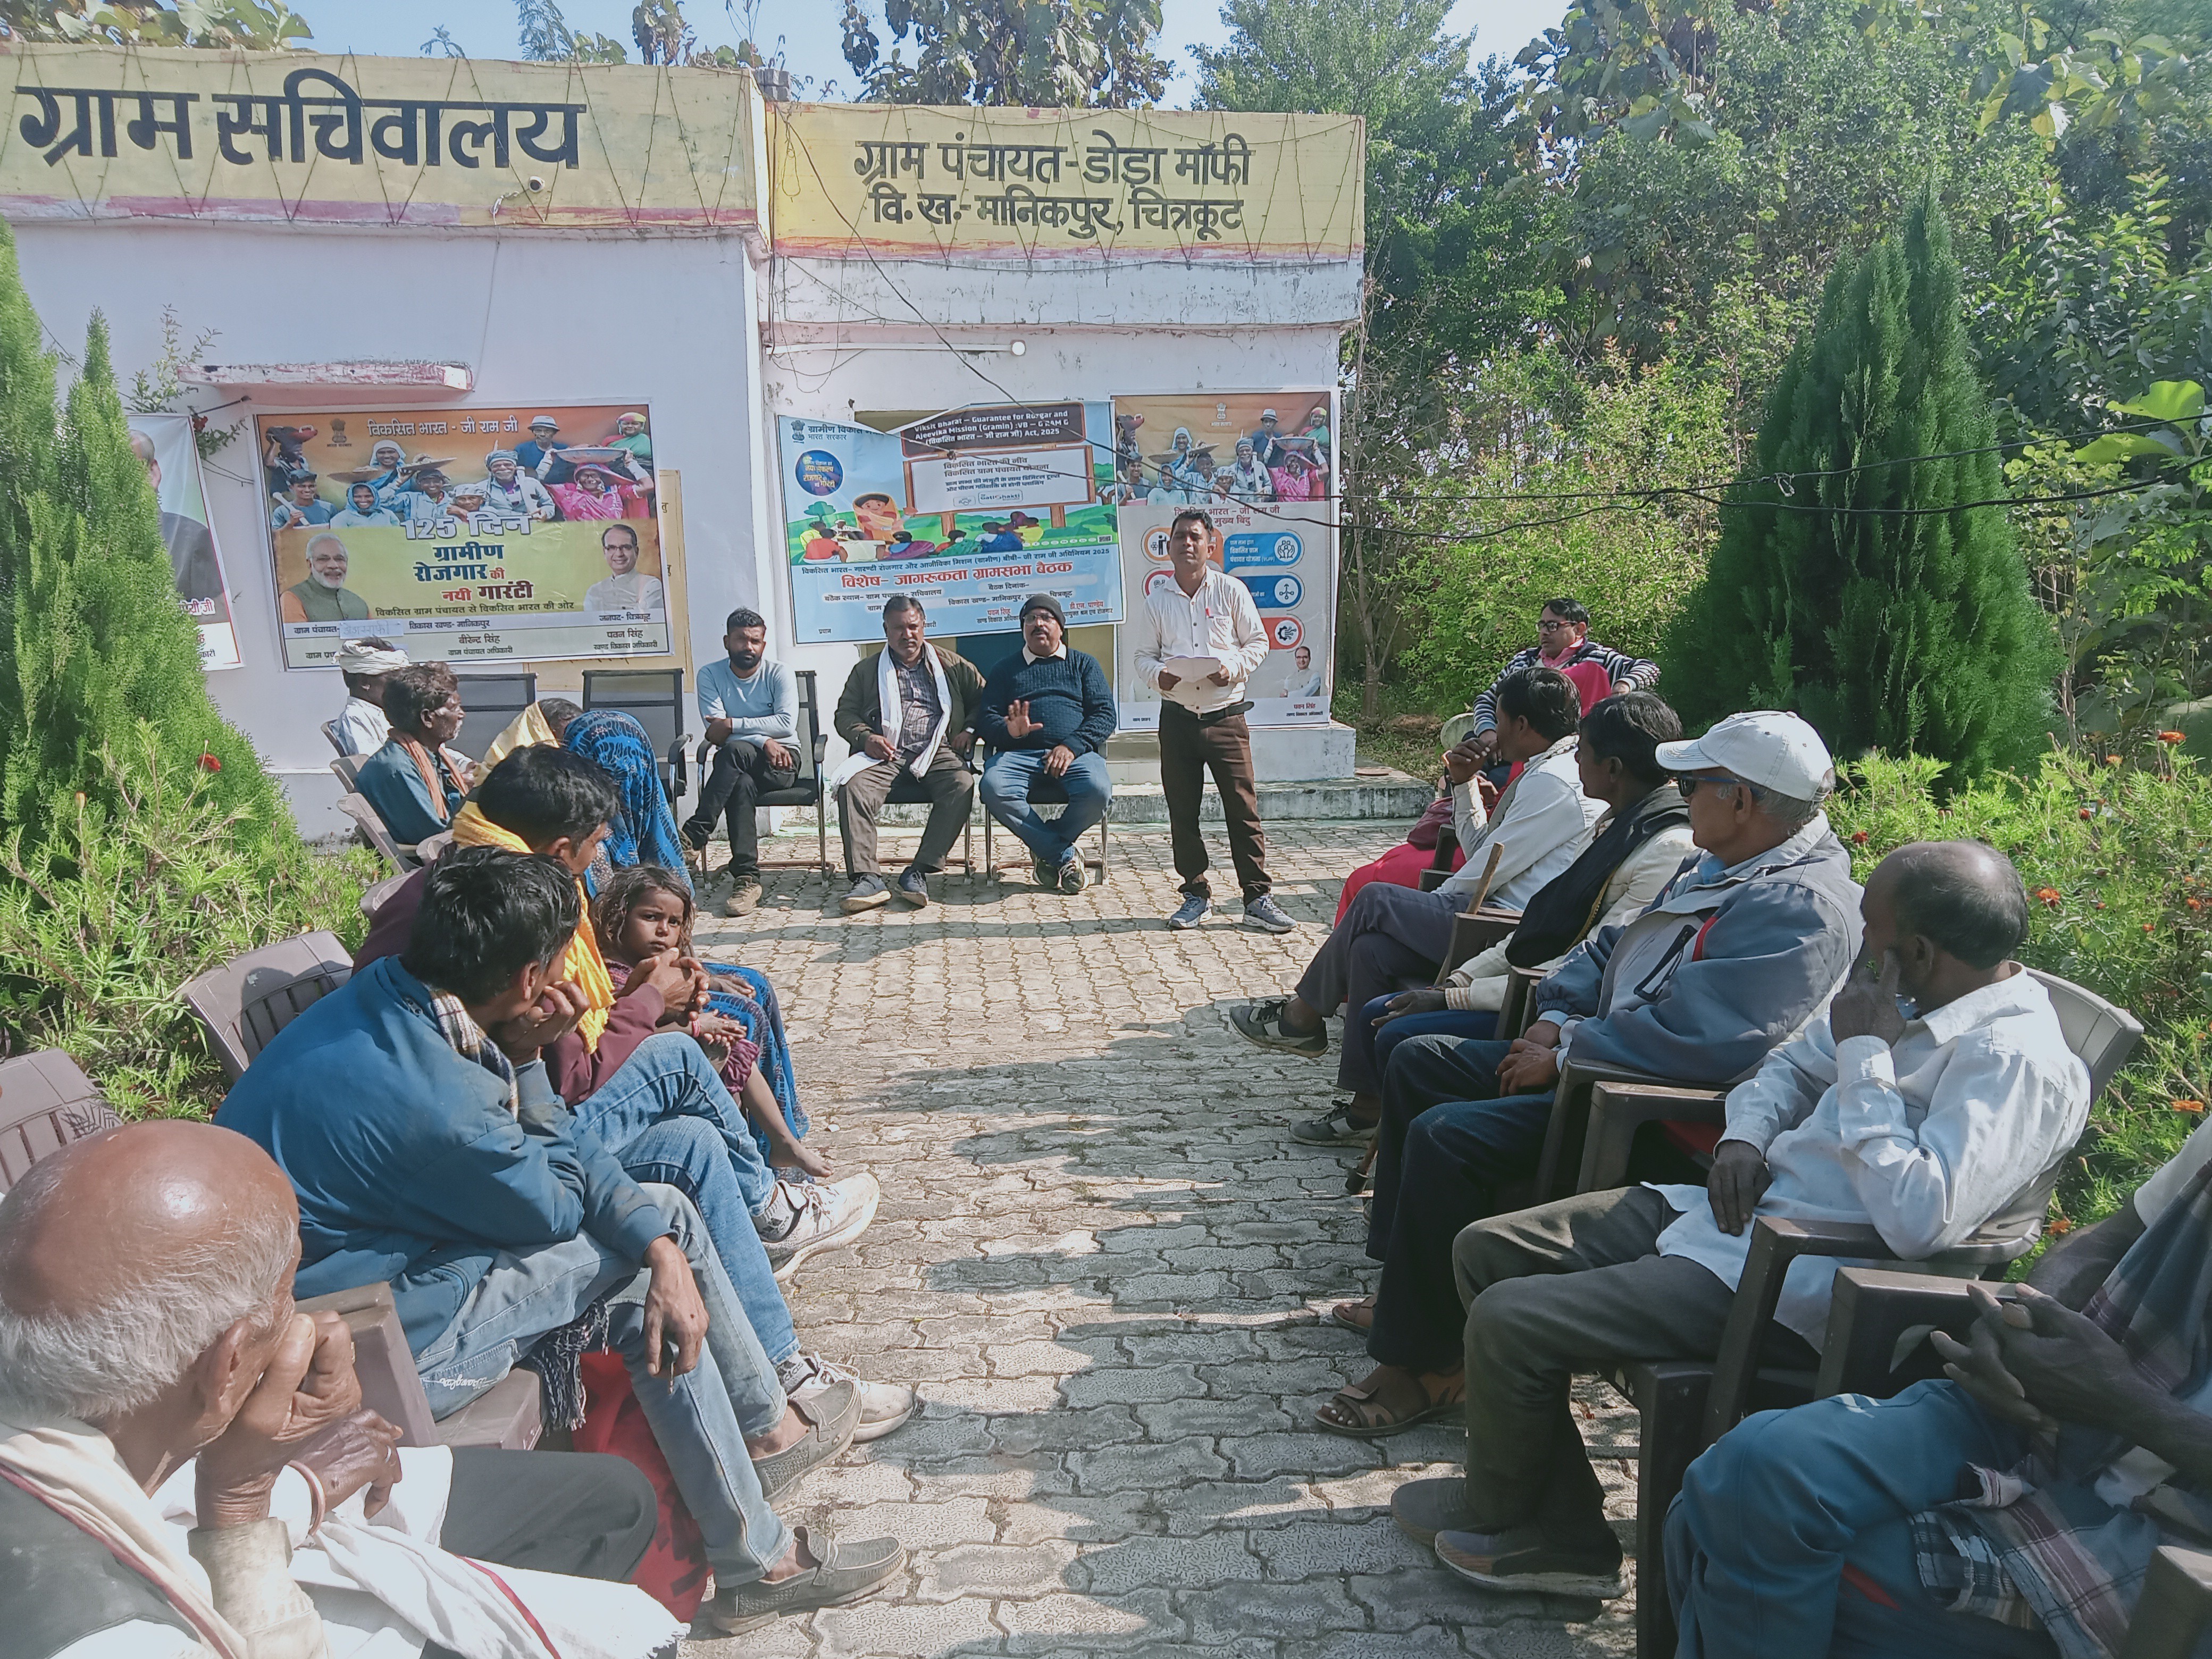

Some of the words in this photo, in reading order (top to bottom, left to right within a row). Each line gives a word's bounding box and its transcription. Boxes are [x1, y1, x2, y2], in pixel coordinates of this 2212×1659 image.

[15, 86, 200, 165] ग्राम
[212, 68, 587, 169] सचिवालय
[854, 140, 931, 186] ग्राम
[1175, 132, 1256, 186] मॉफी
[1127, 186, 1244, 240] चित्रकूट
[367, 418, 416, 437] विकसित
[419, 421, 448, 435] भारत
[460, 416, 476, 434] जी
[479, 420, 499, 433] राम
[502, 415, 518, 433] जी
[808, 424, 835, 433] ग्रामीण
[915, 423, 936, 432] Viksit
[937, 418, 962, 429] Bharat
[971, 414, 1011, 423] Guarantee
[915, 429, 948, 440] Ajeevika
[948, 424, 977, 433] Mission
[944, 468, 975, 477] विकसित
[1270, 505, 1280, 514] जी
[400, 517, 457, 540] 125
[466, 510, 533, 537] दिन
[1214, 517, 1234, 526] मुख्य
[1237, 515, 1251, 525] बिंदु
[432, 541, 505, 562] ग्रामीण
[413, 562, 488, 582] रोजगार
[489, 567, 505, 580] की
[920, 560, 951, 568] आजीविका
[893, 569, 968, 585] जागरूकता
[973, 564, 1032, 580] ग्रामसभा
[1036, 560, 1073, 574] बैठक
[441, 588, 472, 601] नयी
[477, 580, 534, 600] गारंटी
[375, 607, 411, 617] विकसित
[435, 605, 465, 614] पंचायत
[468, 604, 477, 613] से
[480, 603, 515, 613] विकसित
[518, 603, 540, 611] भारत
[543, 600, 555, 609] की
[557, 600, 574, 609] ओर
[626, 611, 651, 622] चित्रकूट
[1000, 607, 1011, 616] सिंह
[409, 621, 432, 630] विकास
[457, 619, 490, 629] मानिकपुर
[484, 633, 500, 644] सिंह
[627, 628, 643, 639] सिंह
